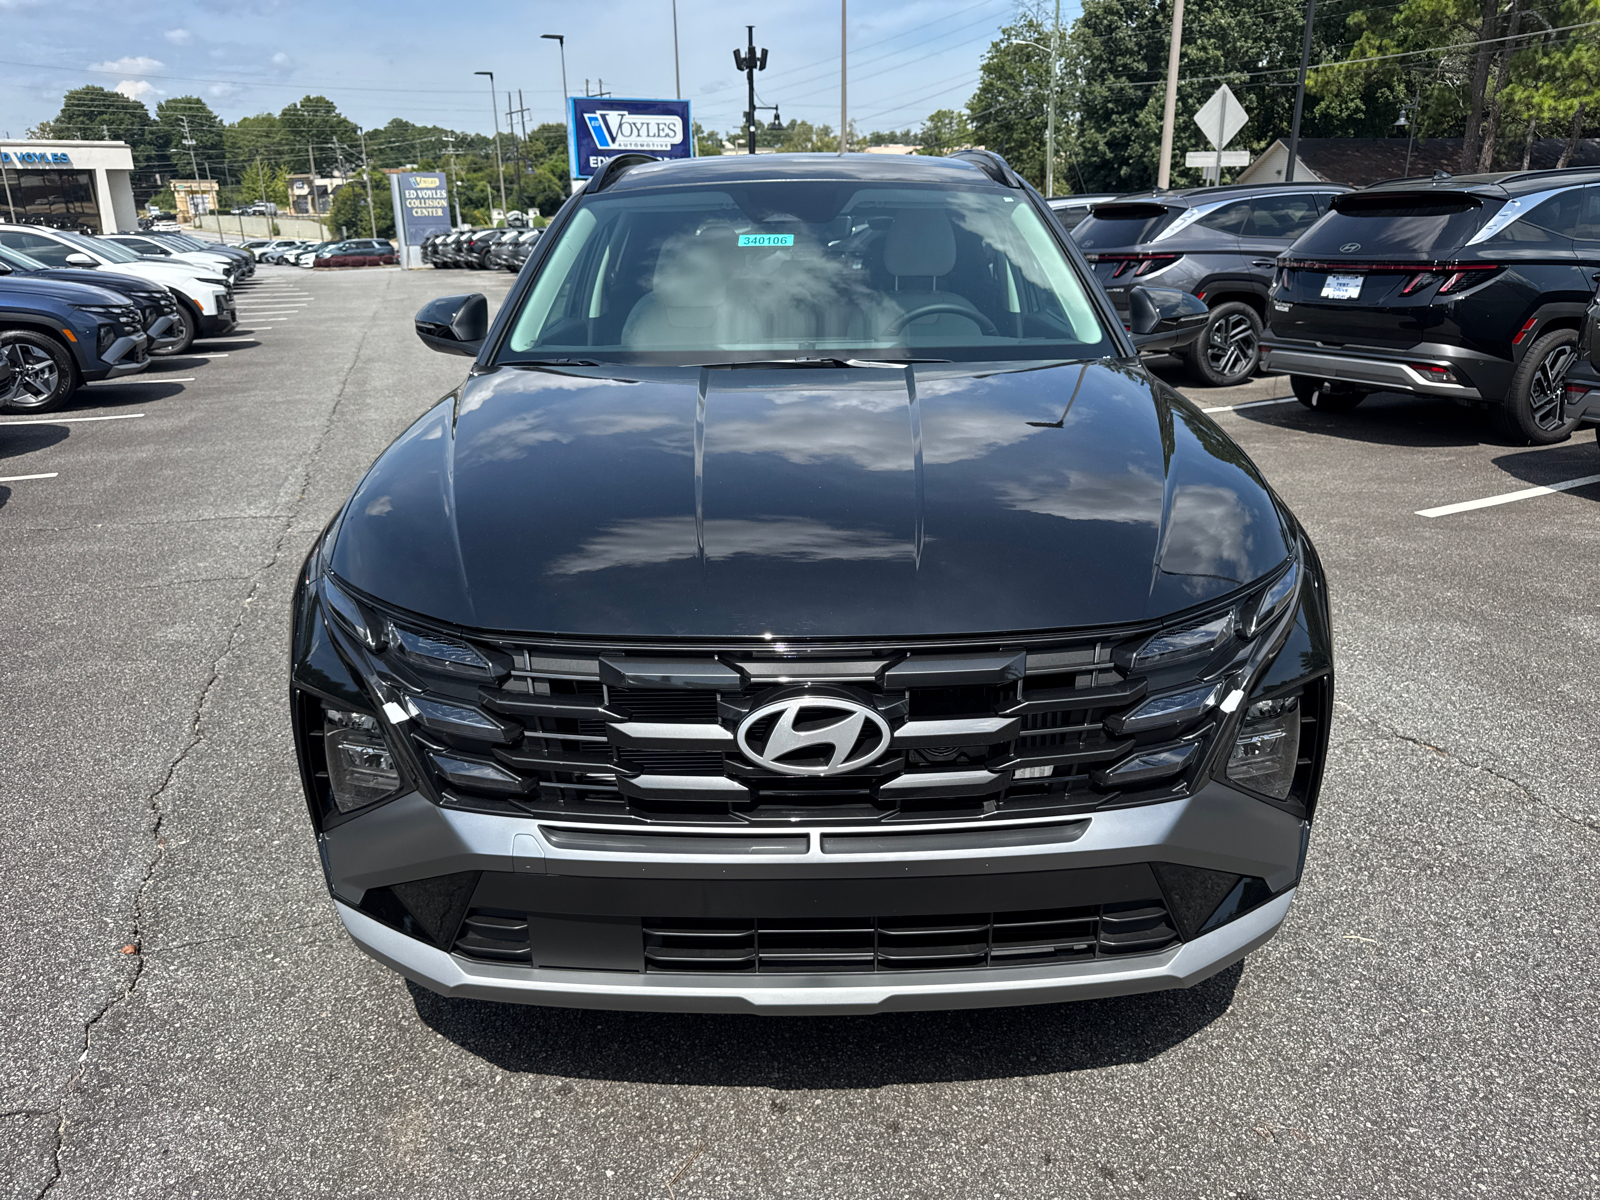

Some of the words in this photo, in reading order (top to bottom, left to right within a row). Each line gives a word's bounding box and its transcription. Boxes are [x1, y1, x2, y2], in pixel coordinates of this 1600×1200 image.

[599, 113, 677, 145] VOYLES
[1, 152, 11, 162] D
[13, 152, 70, 163] VOYLES
[405, 190, 417, 198] ED
[417, 190, 447, 198] VOYLES
[406, 199, 447, 208] COLLISION
[412, 208, 443, 217] CENTER
[743, 236, 787, 245] 340106
